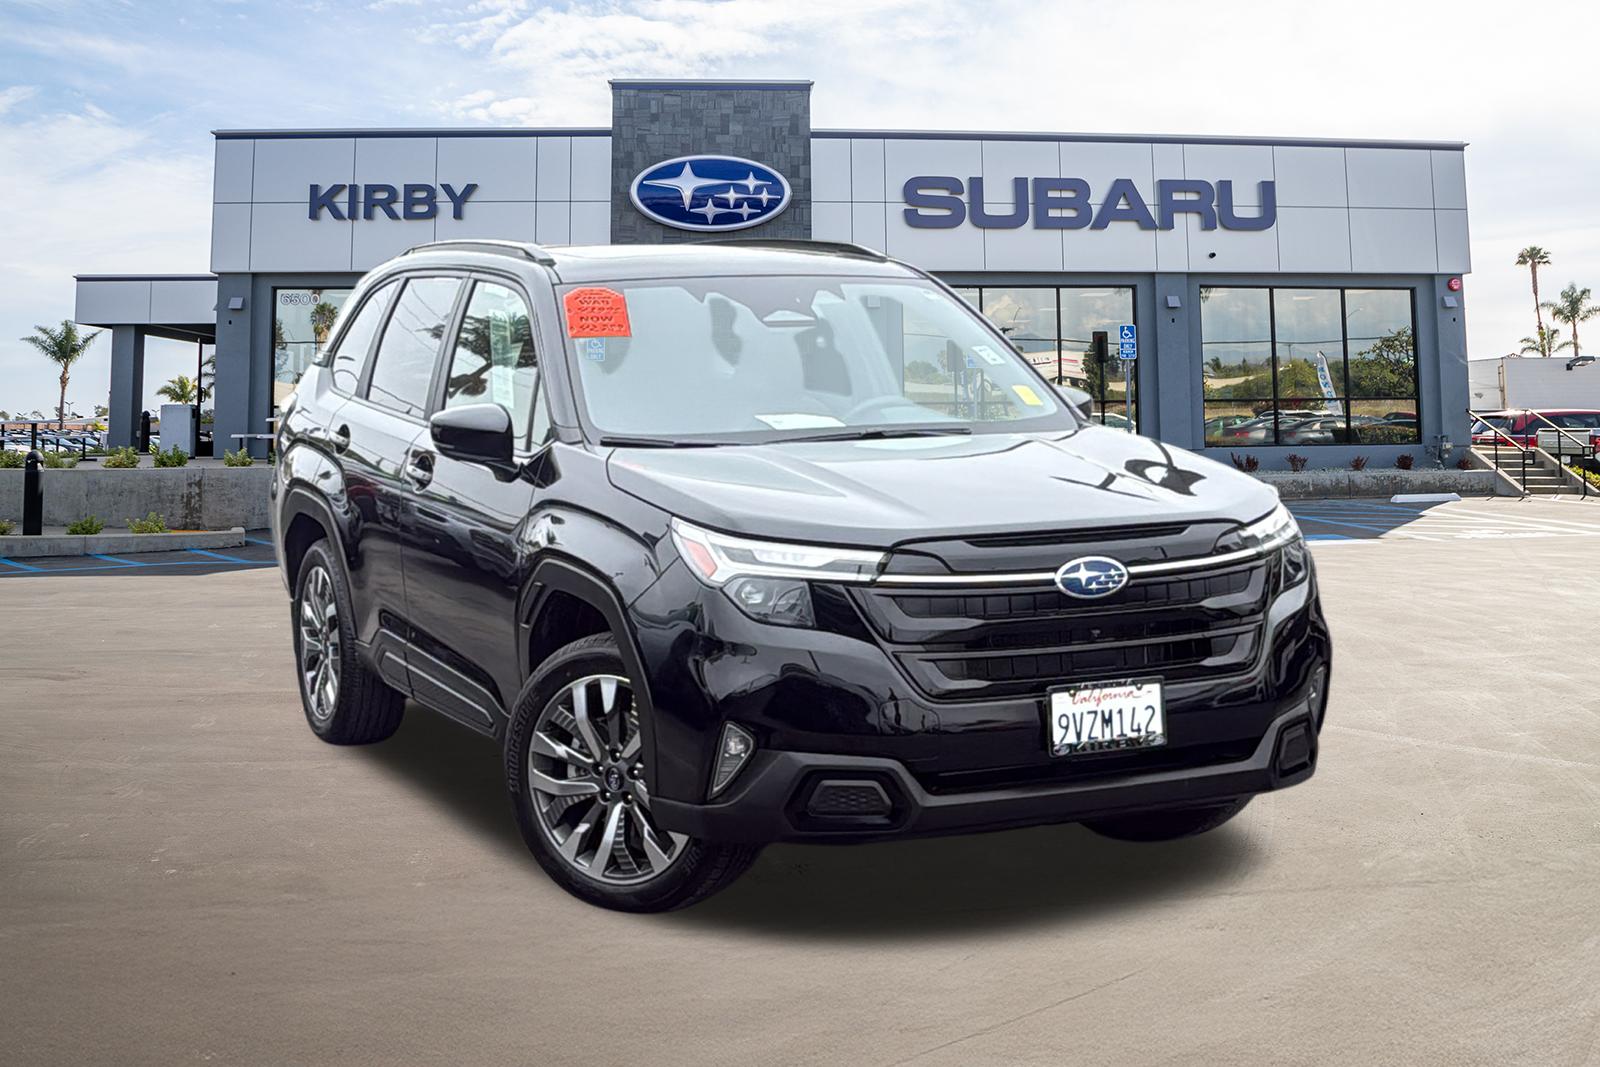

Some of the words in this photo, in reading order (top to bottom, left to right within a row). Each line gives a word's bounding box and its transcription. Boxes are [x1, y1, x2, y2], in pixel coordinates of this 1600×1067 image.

[308, 183, 479, 221] KIRBY
[902, 176, 1278, 231] SUBARU
[1072, 688, 1141, 707] California
[508, 688, 540, 793] BRIDGESTONE
[1058, 705, 1157, 745] 9VZM142
